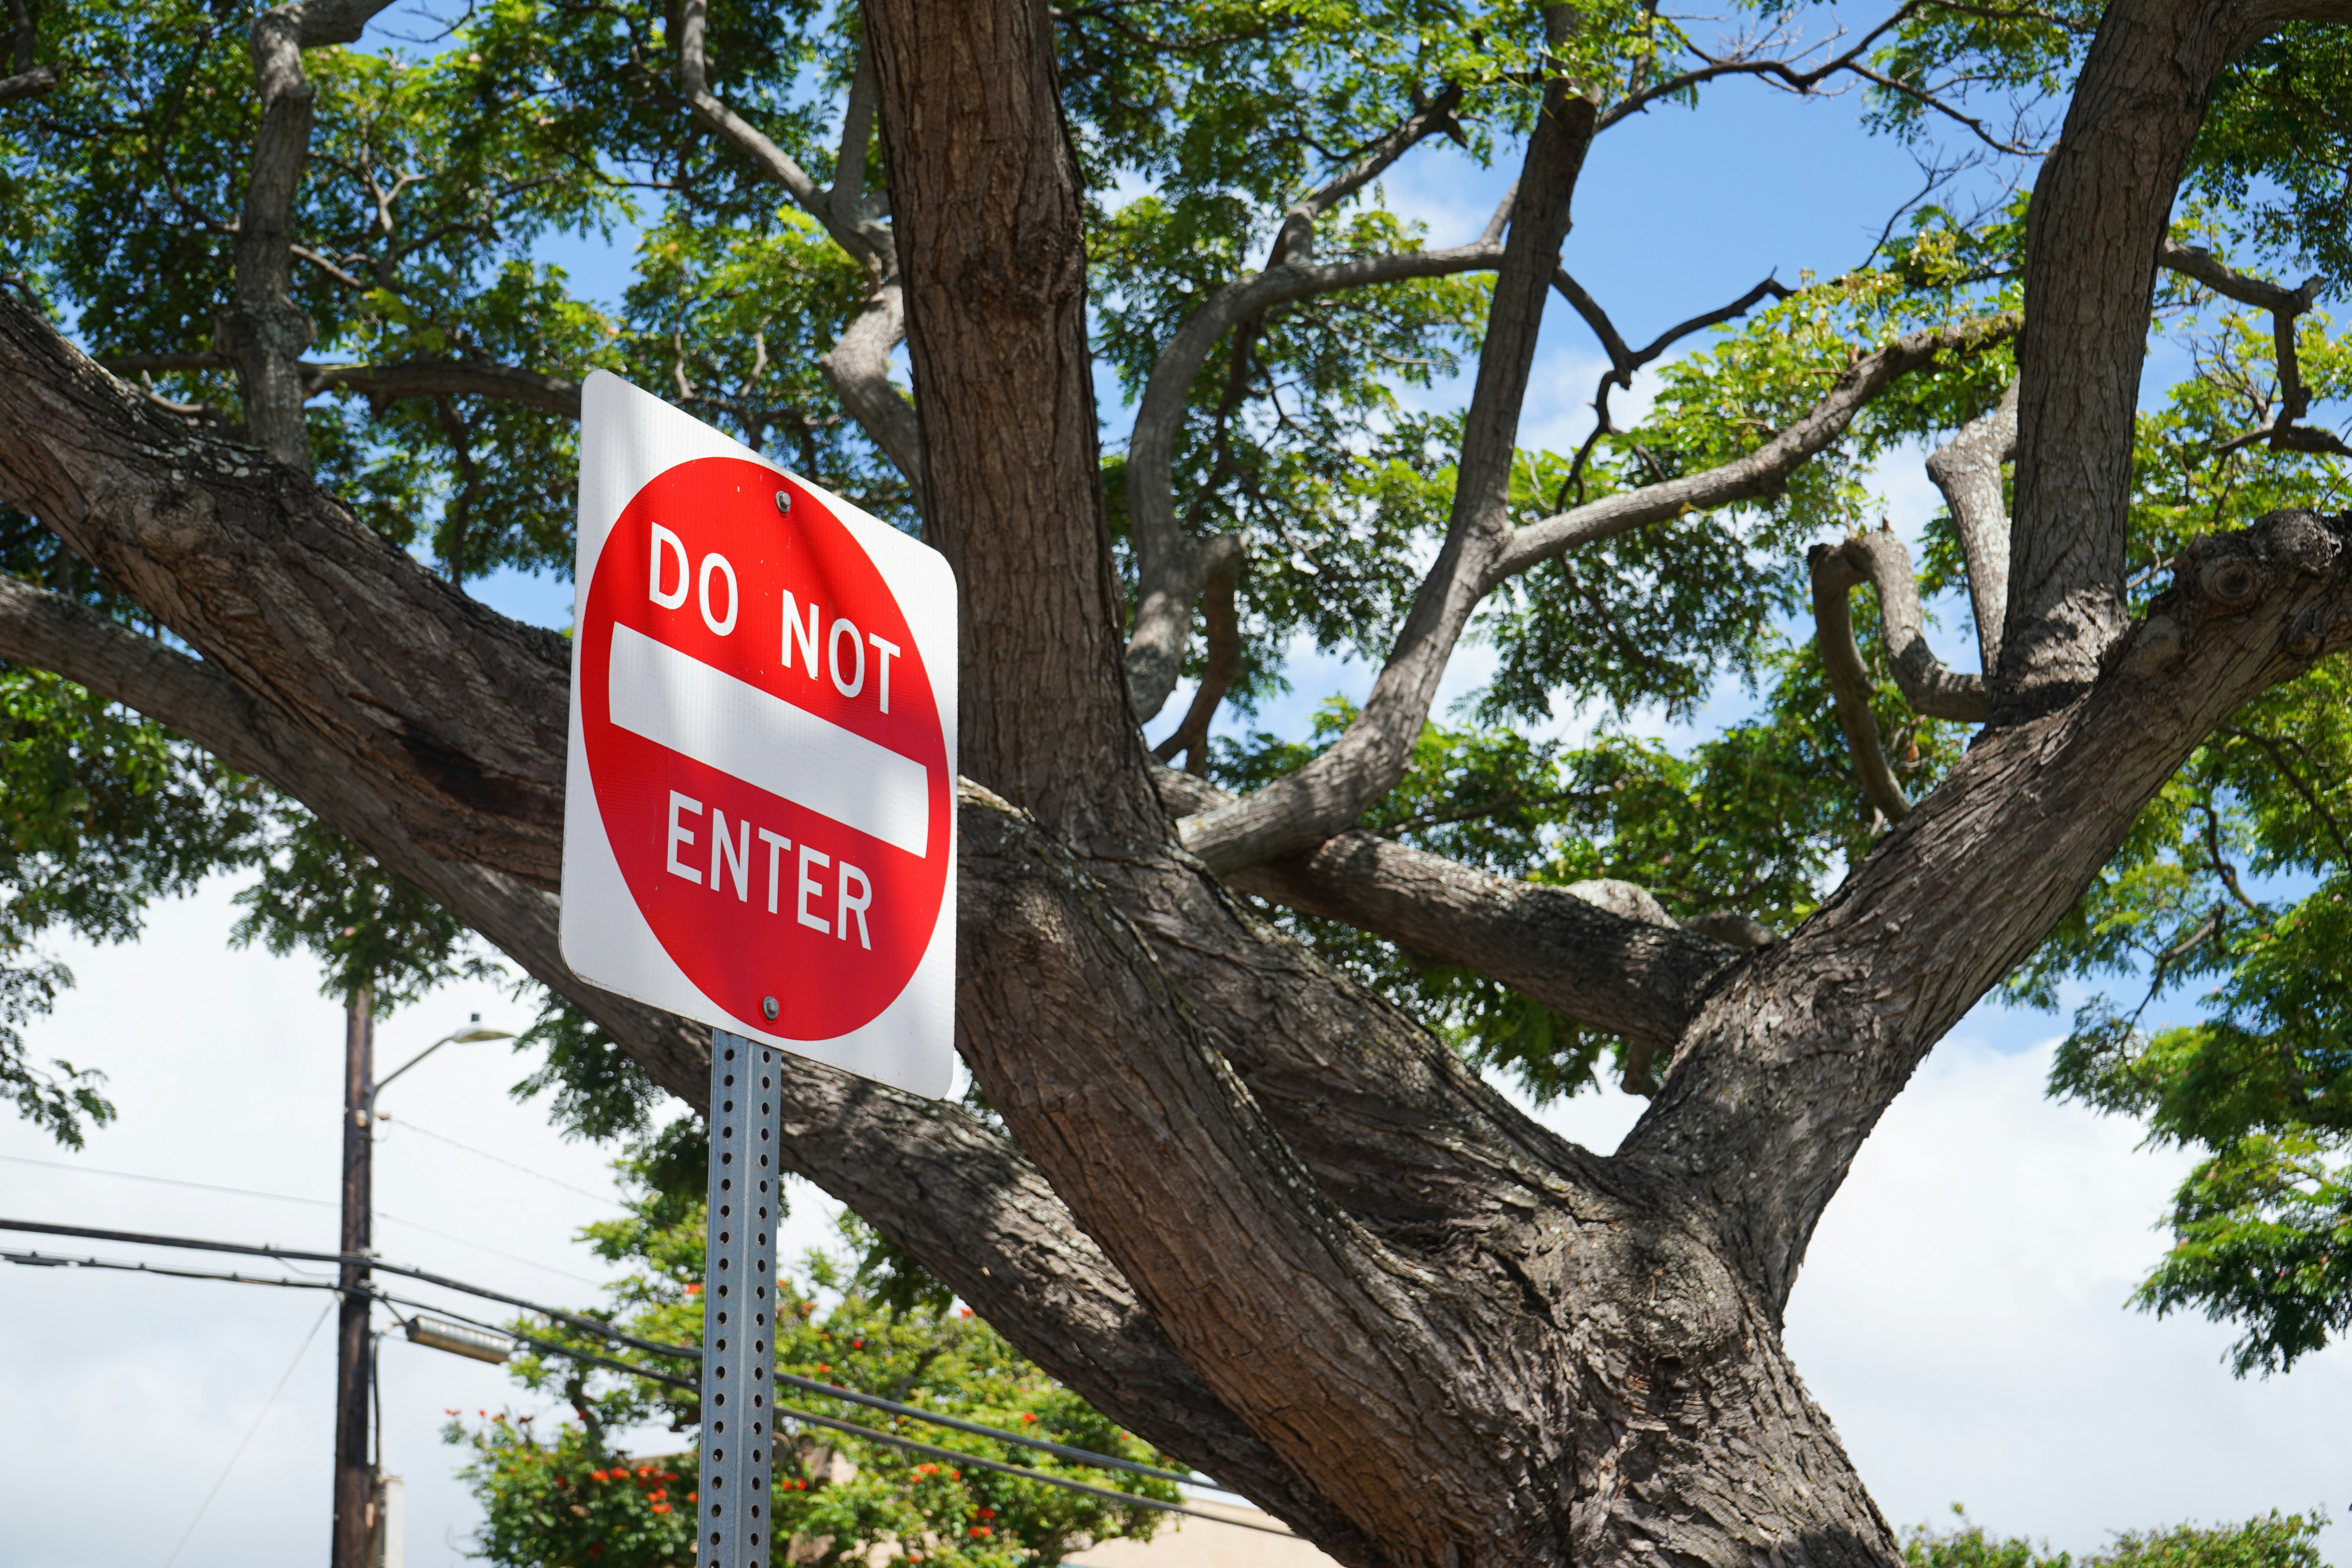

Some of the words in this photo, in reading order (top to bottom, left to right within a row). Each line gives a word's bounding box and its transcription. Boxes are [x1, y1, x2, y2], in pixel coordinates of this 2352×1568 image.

[649, 522, 739, 636] DO
[781, 589, 901, 715] NOT
[666, 789, 872, 951] ENTER
